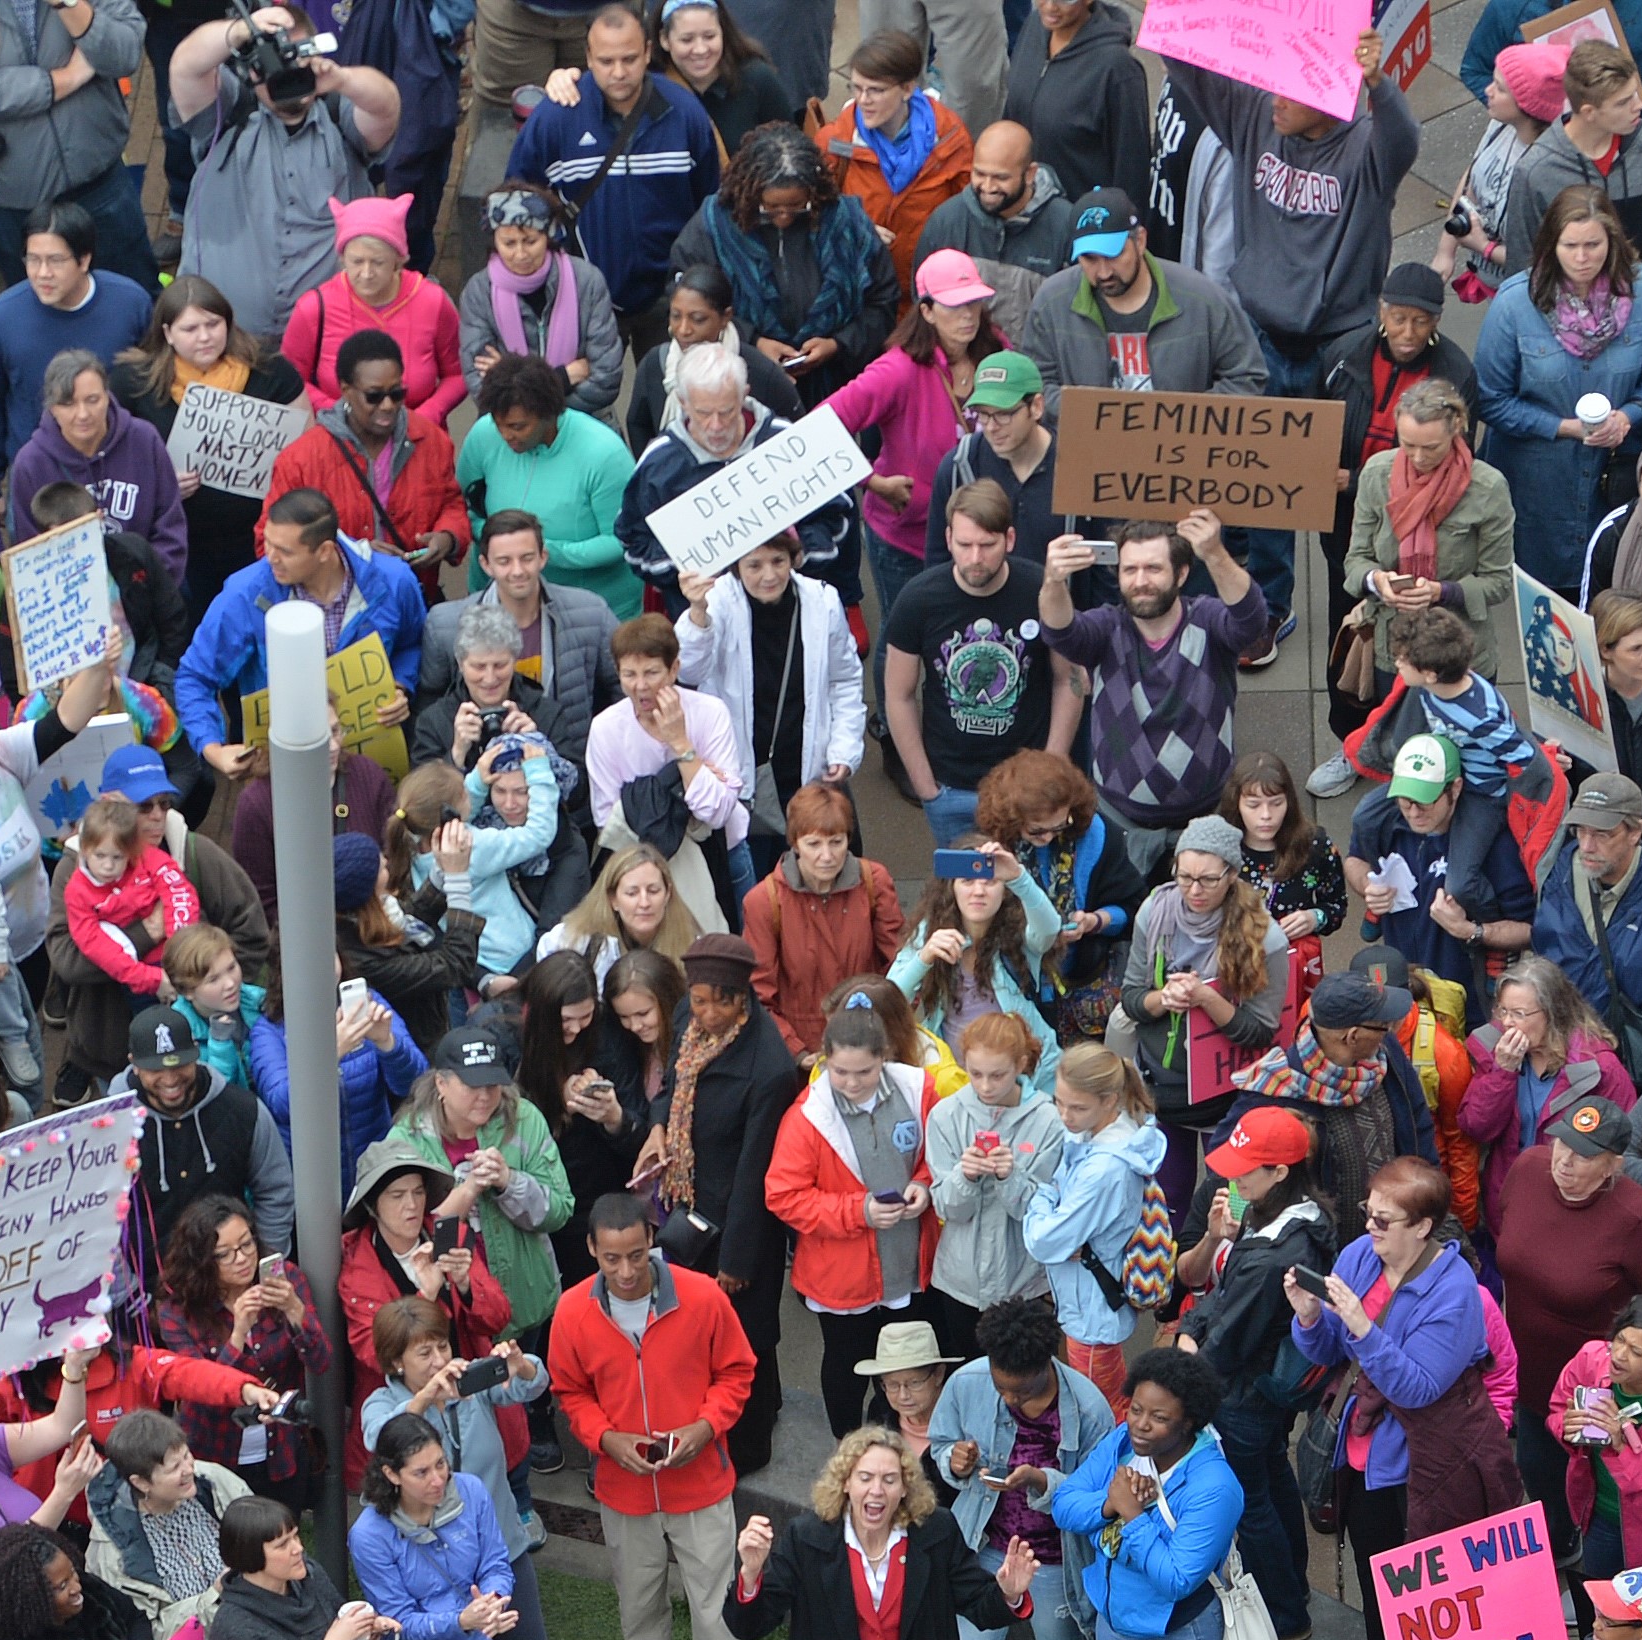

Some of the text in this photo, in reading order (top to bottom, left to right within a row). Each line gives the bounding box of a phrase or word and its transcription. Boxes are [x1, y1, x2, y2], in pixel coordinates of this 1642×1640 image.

[185, 385, 289, 427] SUPPORT
[1093, 400, 1315, 438] FEMINISM
[183, 408, 286, 452] YOUR LOCAL
[196, 434, 264, 468] NASTY
[1155, 444, 1271, 470] IS FOR
[691, 434, 807, 519] DEFEND
[1091, 472, 1304, 510] EVERBODY
[677, 449, 855, 573] HUMAN RIGHTS
[1, 1155, 65, 1200] KEEP
[66, 1140, 118, 1194] YOUR
[49, 1191, 109, 1230] HANDS
[55, 1230, 85, 1263] OF
[1381, 1517, 1545, 1598] WE WILL
